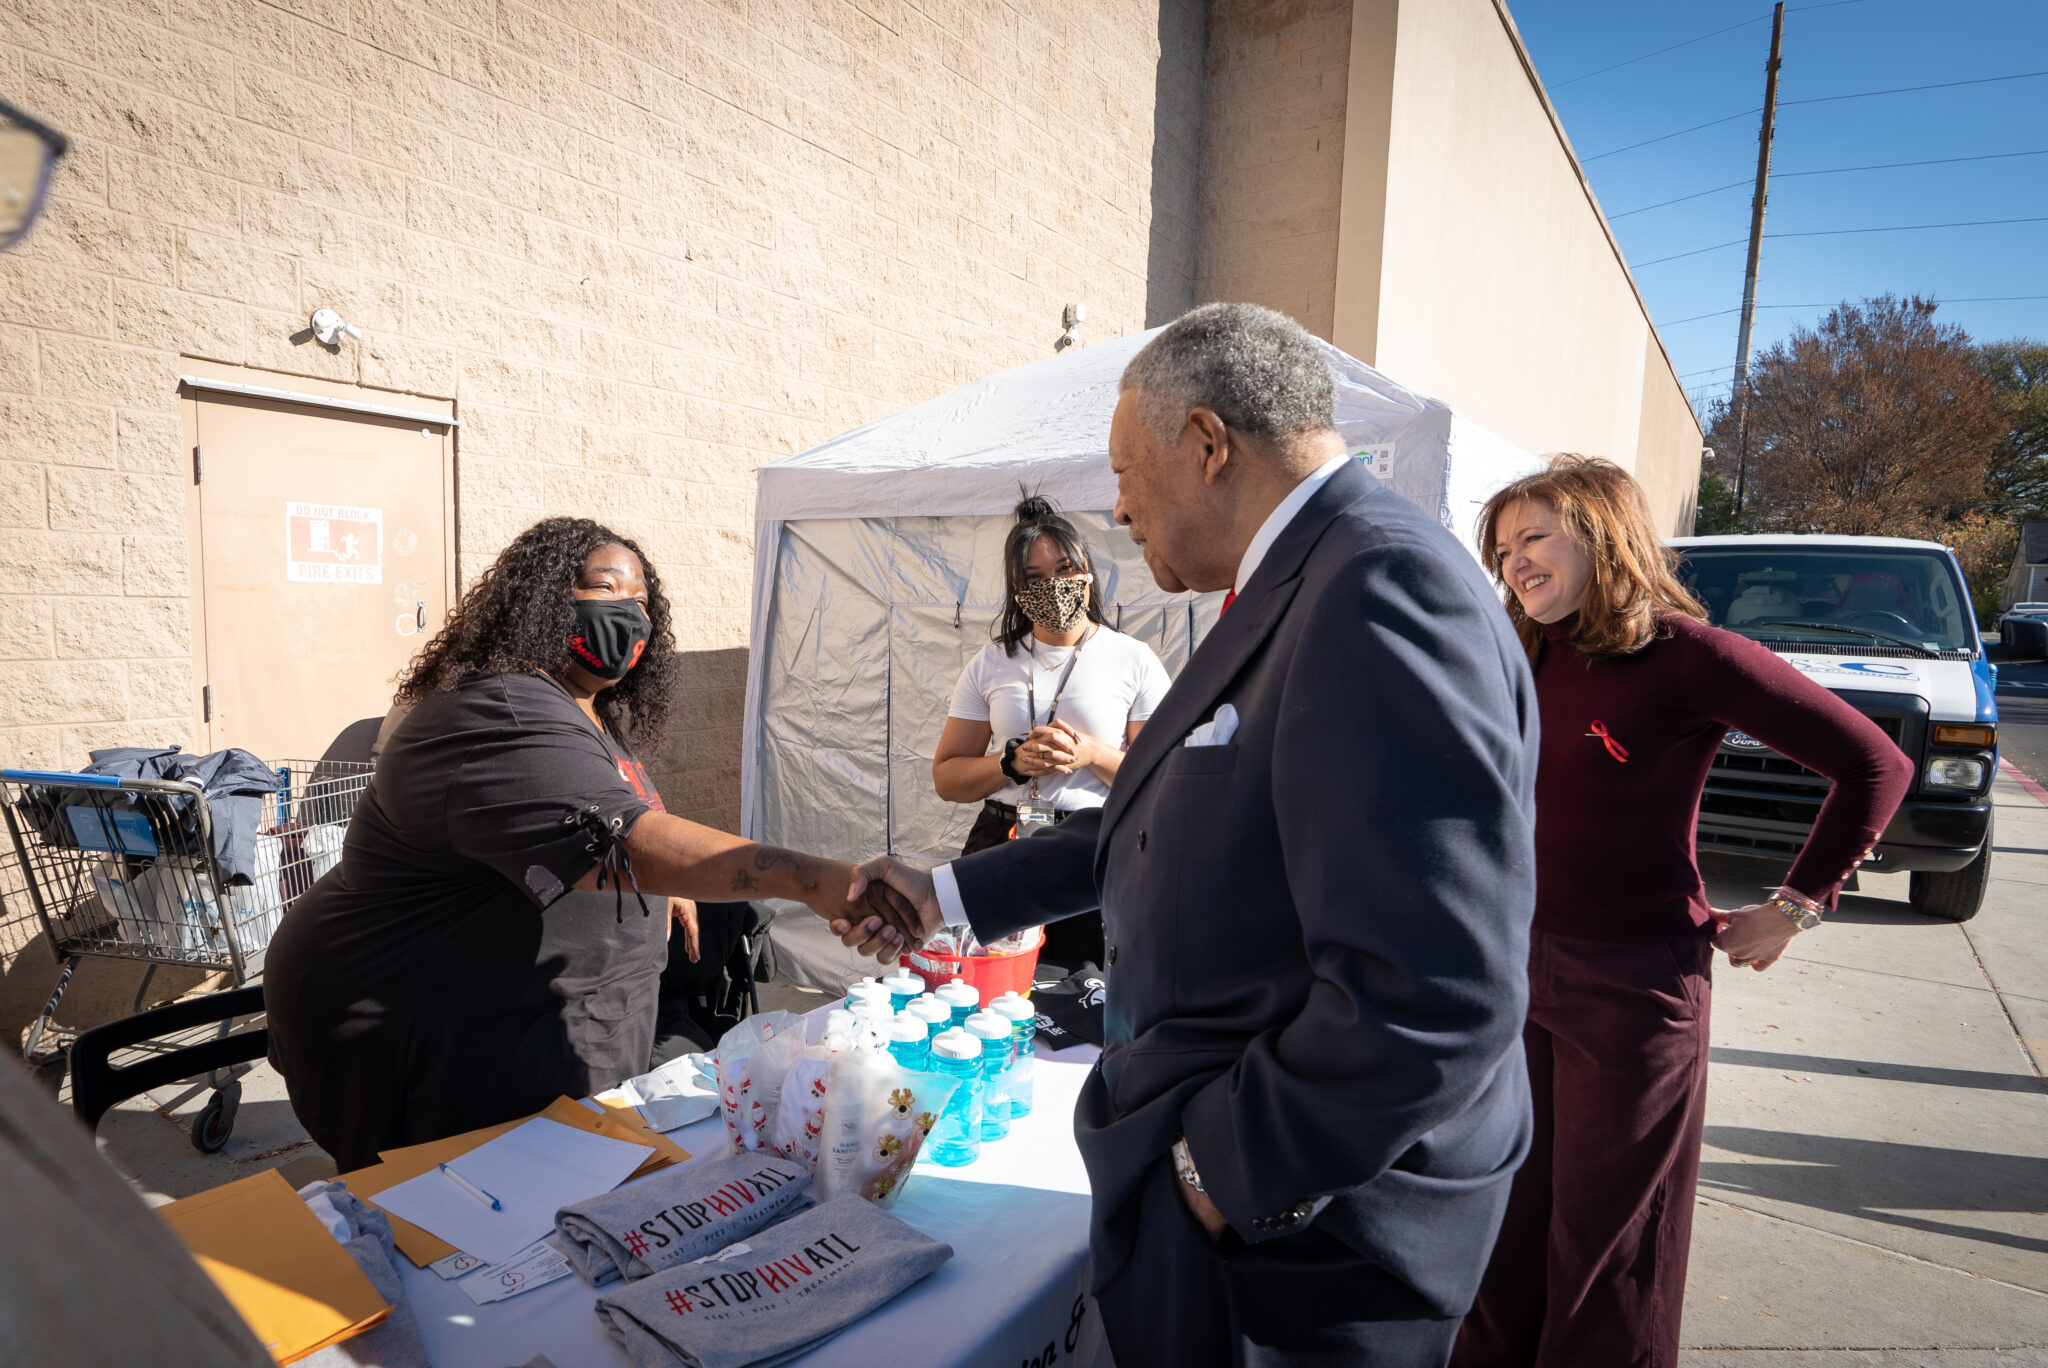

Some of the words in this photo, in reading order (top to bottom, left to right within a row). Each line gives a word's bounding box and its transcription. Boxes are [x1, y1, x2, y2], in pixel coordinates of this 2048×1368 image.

[296, 504, 311, 516] DO
[314, 506, 334, 518] NOT
[337, 508, 370, 521] BLOCK
[298, 563, 330, 579] FIRE
[335, 565, 374, 581] EXITS
[623, 1167, 797, 1258] #STOPHIVATL
[661, 1247, 685, 1262] TEST
[742, 1194, 792, 1225] TREATMENT
[664, 1232, 861, 1316] #STOPHIVATL
[796, 1260, 856, 1299] TREATMENT
